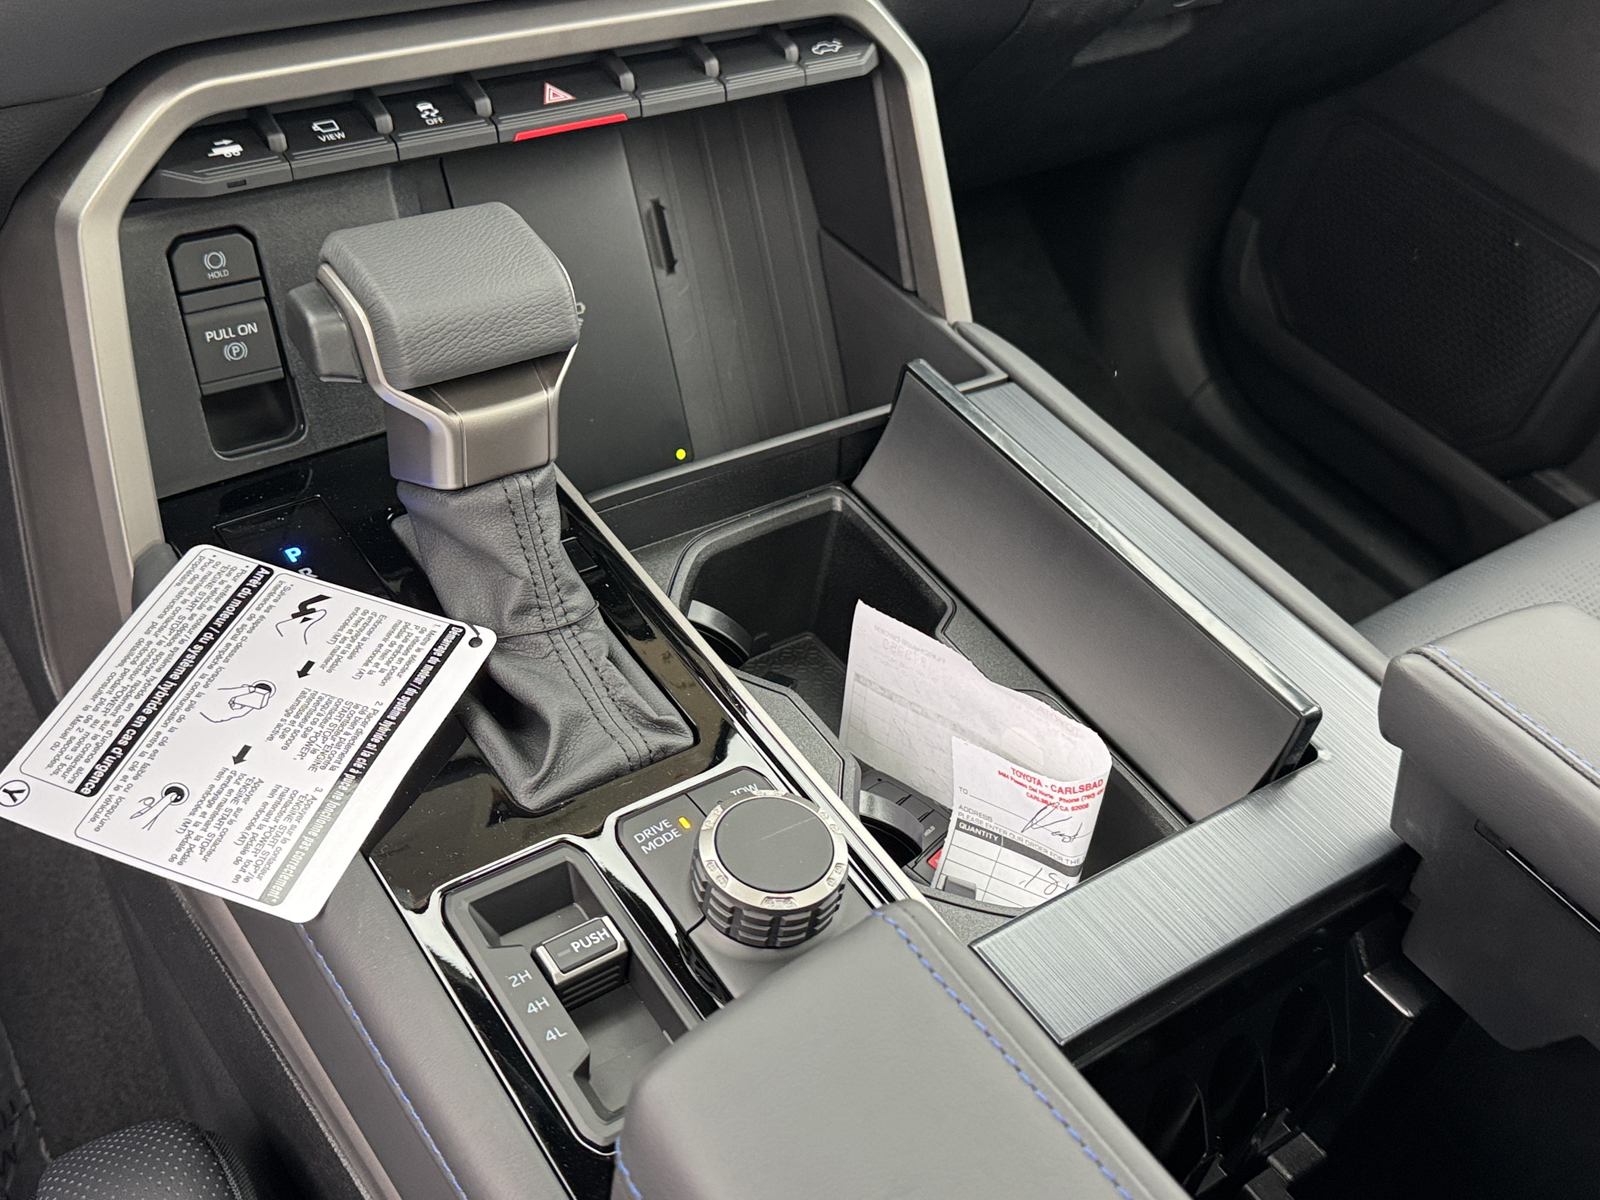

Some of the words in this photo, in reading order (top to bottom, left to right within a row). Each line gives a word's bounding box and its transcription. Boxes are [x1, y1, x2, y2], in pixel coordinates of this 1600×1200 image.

[425, 117, 444, 125] OFF
[318, 131, 345, 142] VIEW
[208, 269, 230, 279] HOLD
[205, 327, 236, 342] PULL
[237, 322, 258, 336] ON
[199, 558, 215, 572] Pour
[284, 547, 302, 562] P
[186, 573, 200, 585] des
[225, 566, 238, 577] que
[231, 568, 247, 582] Pour
[246, 567, 270, 588] Arrêt
[187, 570, 213, 597] maintenir
[213, 584, 232, 604] arrêter
[185, 591, 206, 612] START
[196, 587, 220, 610] véhicule
[153, 606, 182, 638] contacteur
[213, 598, 242, 627] moteur
[143, 620, 158, 635] plus
[187, 613, 207, 635] moteur
[433, 626, 463, 656] Démarrage
[129, 640, 153, 665] enfoncé
[155, 646, 180, 673] système
[169, 644, 203, 680] système
[128, 647, 157, 681] contacteur
[141, 651, 165, 677] appuyer
[413, 664, 433, 685] moteur
[90, 671, 117, 702] consulter
[105, 667, 130, 695] pendant
[133, 675, 157, 700] hybride
[92, 697, 107, 712] plus
[109, 679, 142, 717] rapidement
[142, 680, 177, 714] hybride
[293, 690, 318, 719] retentisse
[386, 695, 410, 720] système
[318, 697, 344, 729] contacteur
[333, 700, 354, 722] START
[358, 705, 369, 715] clé
[360, 708, 379, 728] Placer
[59, 714, 84, 740] Manuel
[98, 719, 110, 732] sur
[111, 714, 125, 728] cas
[330, 709, 356, 742] contacteur
[347, 715, 363, 730] bien
[370, 719, 395, 743] hybride
[70, 731, 90, 752] moins
[117, 728, 136, 746] cas
[278, 726, 291, 739] que
[280, 728, 300, 750] sonore
[300, 726, 313, 739] que
[333, 736, 346, 750] plat
[45, 735, 76, 769] secondes.
[334, 728, 363, 764] directement
[60, 742, 92, 779] contacteur
[319, 749, 337, 770] contre
[352, 757, 367, 769] clé
[67, 766, 84, 784] alors
[80, 747, 122, 794] d'urgence
[1010, 766, 1042, 788] TOYOTA
[1050, 778, 1104, 794] CARLSBAD
[336, 772, 355, 791] puce
[958, 786, 968, 795] TO
[2, 788, 26, 803] Y
[308, 800, 340, 836] fonctionne
[959, 804, 993, 822] ADDRESS
[634, 818, 672, 844] DRIVE
[640, 828, 682, 854] MODE
[958, 822, 998, 841] QUANTITY
[958, 811, 984, 826] PLEASE
[985, 822, 1008, 836] ENTER
[1009, 832, 1024, 843] OUR
[1024, 840, 1048, 854] ORDER
[1050, 850, 1063, 862] FOR
[298, 835, 314, 851] pas
[570, 928, 611, 953] PUSH
[508, 970, 532, 988] 2H
[527, 996, 550, 1014] 4H
[546, 1027, 568, 1042] 4L
